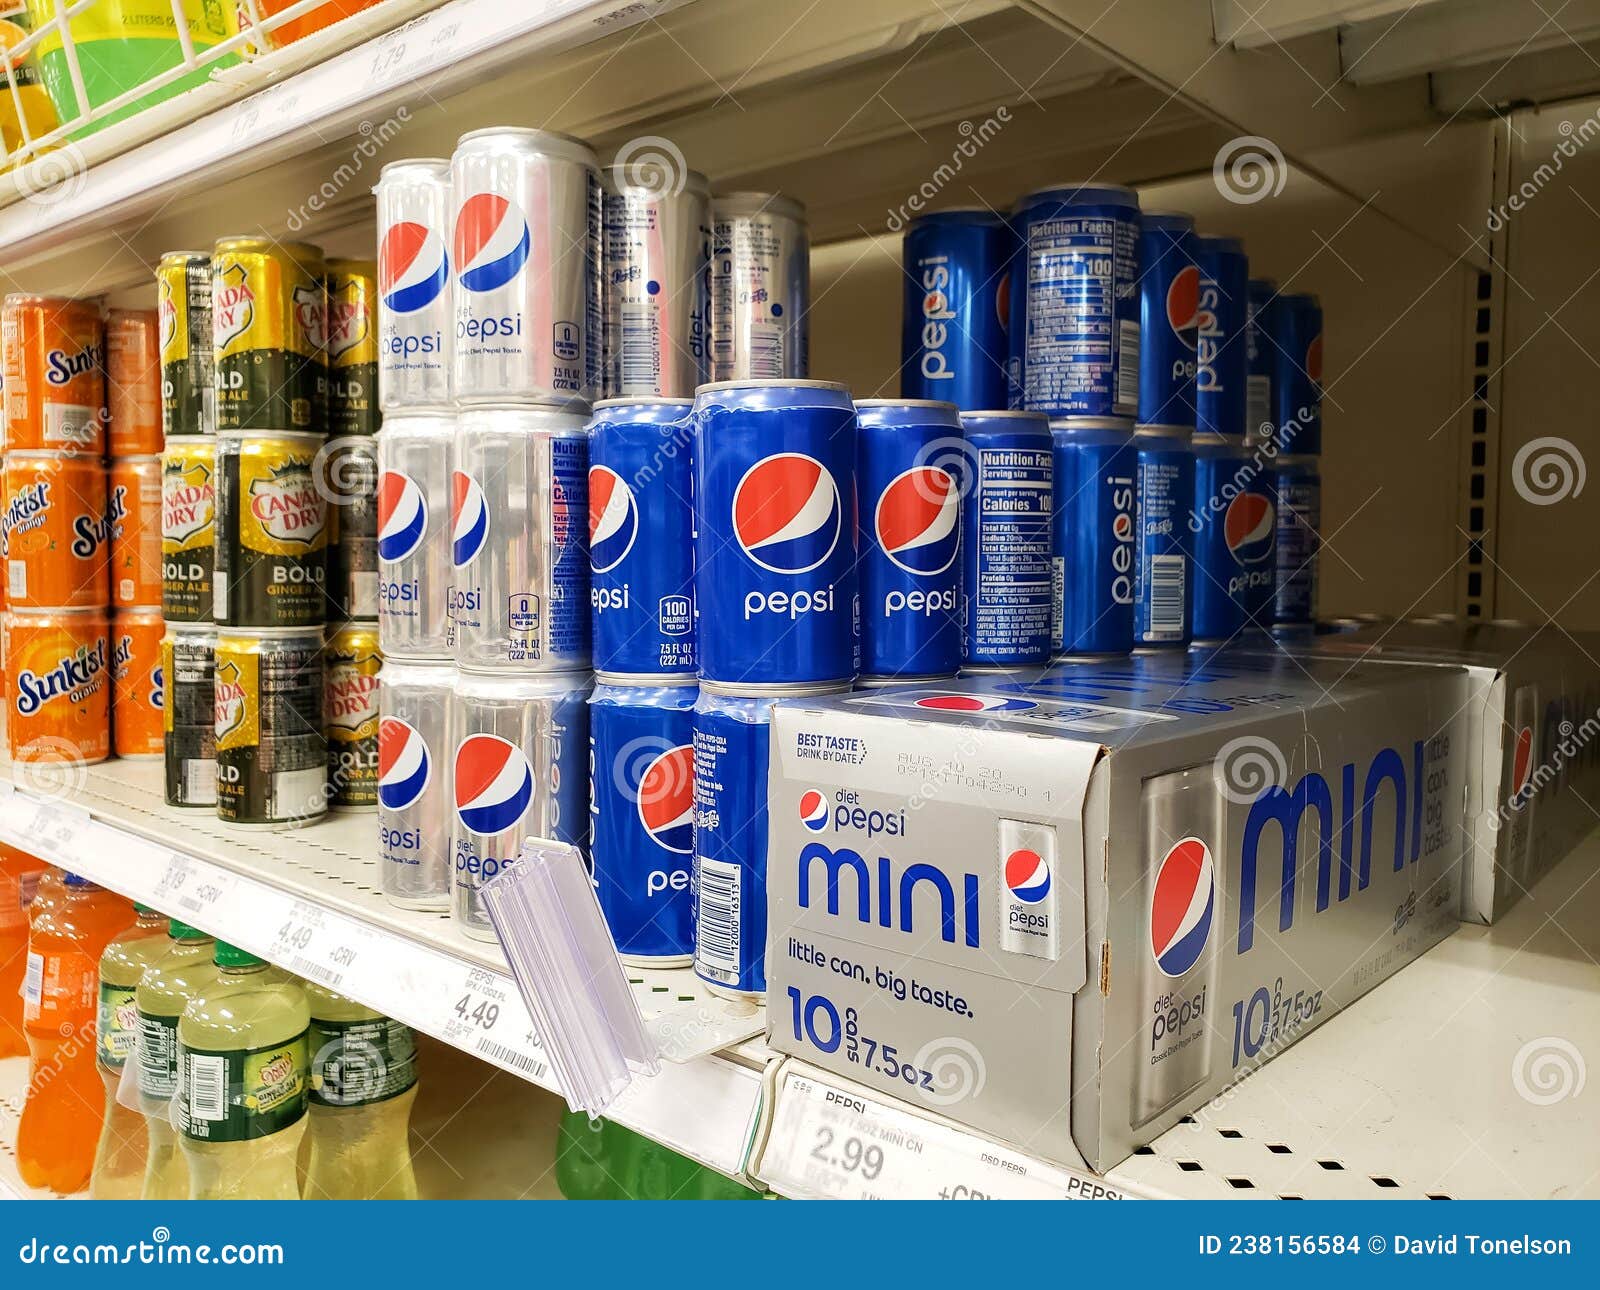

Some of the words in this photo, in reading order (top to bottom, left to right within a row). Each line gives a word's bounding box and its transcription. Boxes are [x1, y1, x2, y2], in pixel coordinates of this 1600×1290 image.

[1081, 220, 1113, 234] Facts
[1088, 259, 1112, 275] 100
[457, 313, 521, 344] pepsi
[918, 256, 956, 380] pepsi
[1197, 279, 1224, 392] pepsi
[983, 452, 1033, 466] Nutrition
[982, 469, 1012, 479] Serving
[283, 505, 323, 532] DRY
[982, 498, 1030, 511] Calories
[1107, 476, 1134, 604] pepsi
[520, 600, 528, 612] 0
[590, 584, 629, 614] epsi
[665, 602, 687, 616] 100
[745, 584, 834, 620] pepsi
[885, 585, 956, 617] pepsi
[662, 616, 689, 624] CALORIES
[660, 655, 677, 667] (222
[672, 644, 681, 653] FL
[683, 643, 692, 653] OZ
[17, 638, 107, 716] Sunkist
[332, 697, 370, 719] DRY
[797, 733, 823, 749] BEST
[825, 735, 858, 751] TASTE
[797, 747, 821, 760] DRINK
[822, 749, 834, 762] BY
[835, 751, 857, 764] DATE
[835, 789, 859, 804] diet
[835, 803, 906, 838] pepsi
[456, 838, 474, 853] diet
[1237, 740, 1424, 955] mini
[456, 852, 523, 881] peps
[731, 884, 740, 915] 16313
[799, 842, 979, 949] mini
[1009, 911, 1048, 928] pepsi
[278, 920, 313, 950] 4.49
[731, 921, 739, 951] 12000
[468, 967, 496, 986] PEPSI
[788, 937, 826, 967] little
[830, 957, 870, 984] can.
[875, 966, 906, 1000] big
[911, 979, 974, 1018] taste.
[454, 993, 500, 1030] 4.49
[1151, 984, 1206, 1051] pepsi
[1154, 992, 1175, 1014] diet
[787, 985, 842, 1054] 10
[1232, 986, 1270, 1070] 10
[845, 1007, 859, 1063] cans
[860, 1037, 935, 1092] 7.5oz
[825, 1091, 866, 1114] PEPSI
[810, 1126, 884, 1180] 2.99
[879, 1128, 904, 1148] MINI
[906, 1138, 923, 1154] CN
[980, 1153, 1000, 1167] DSD
[1001, 1160, 1028, 1177] PEPSI
